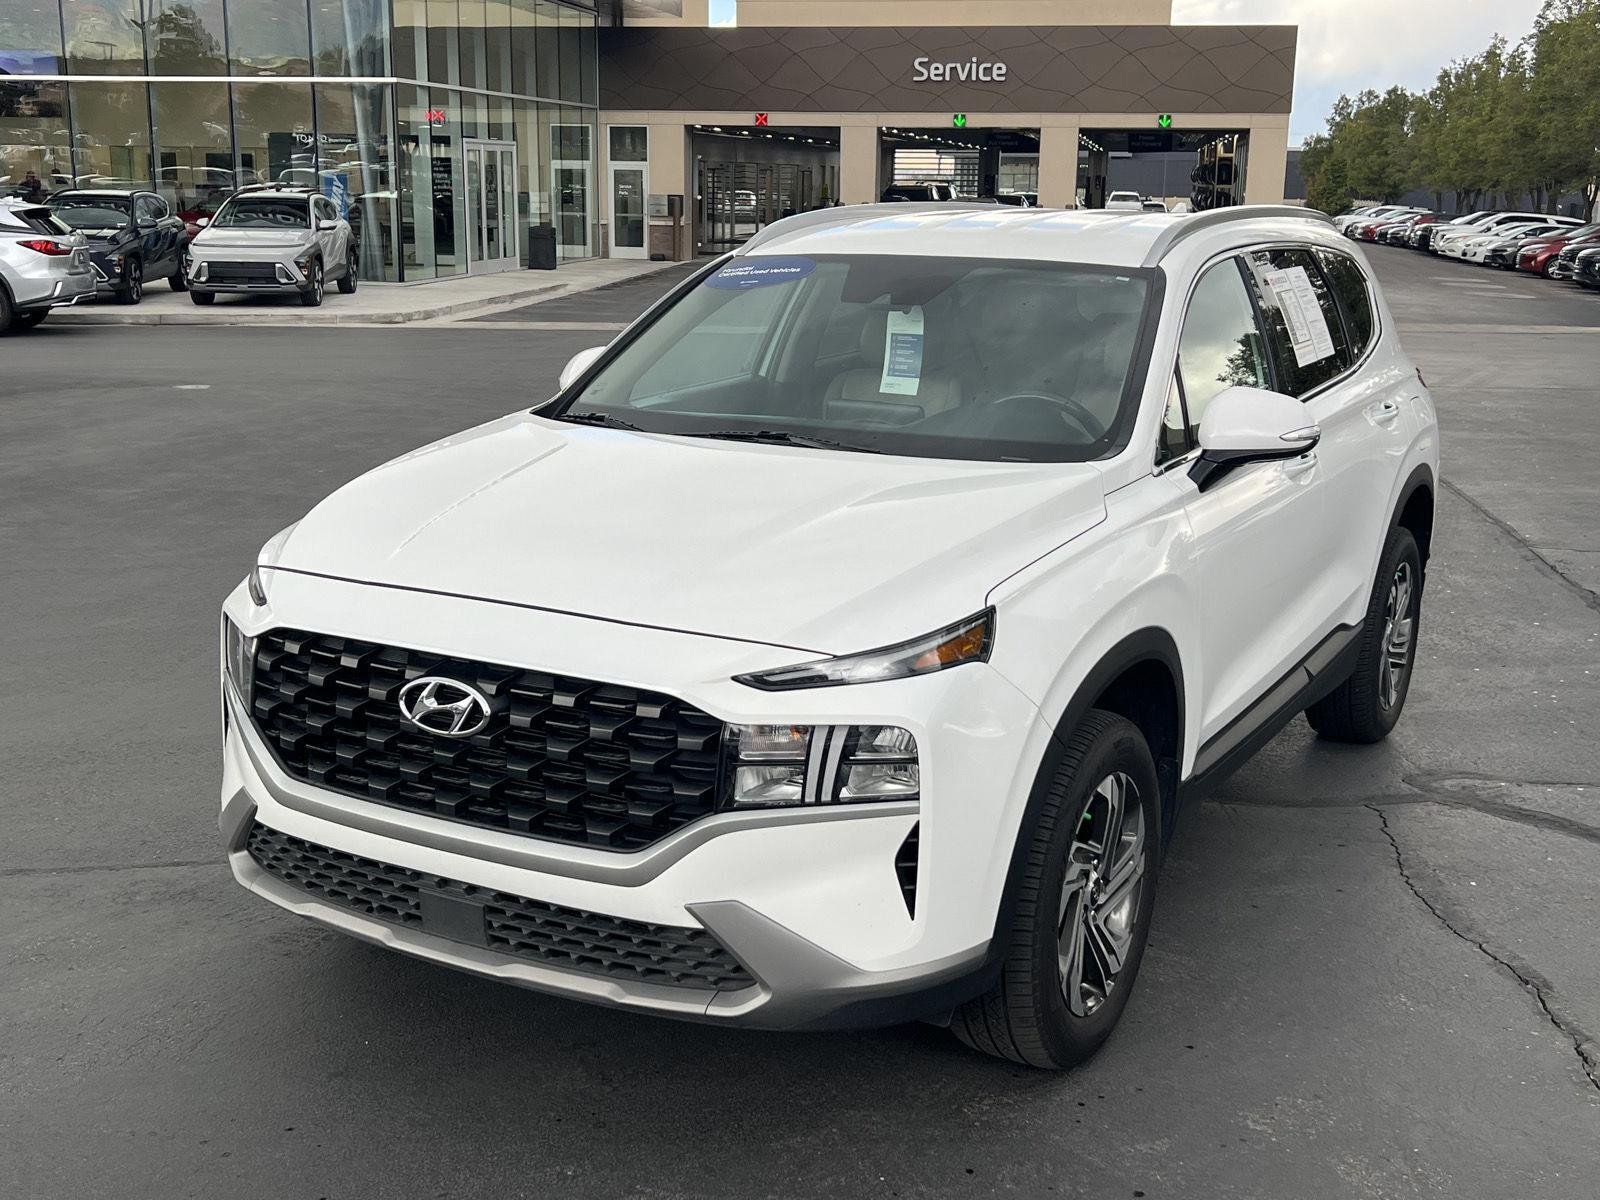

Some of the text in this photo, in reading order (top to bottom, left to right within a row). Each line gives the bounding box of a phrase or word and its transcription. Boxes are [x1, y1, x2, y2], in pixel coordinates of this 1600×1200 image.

[913, 56, 1007, 81] Service
[718, 270, 749, 278] Certified
[723, 265, 755, 274] Hyundai
